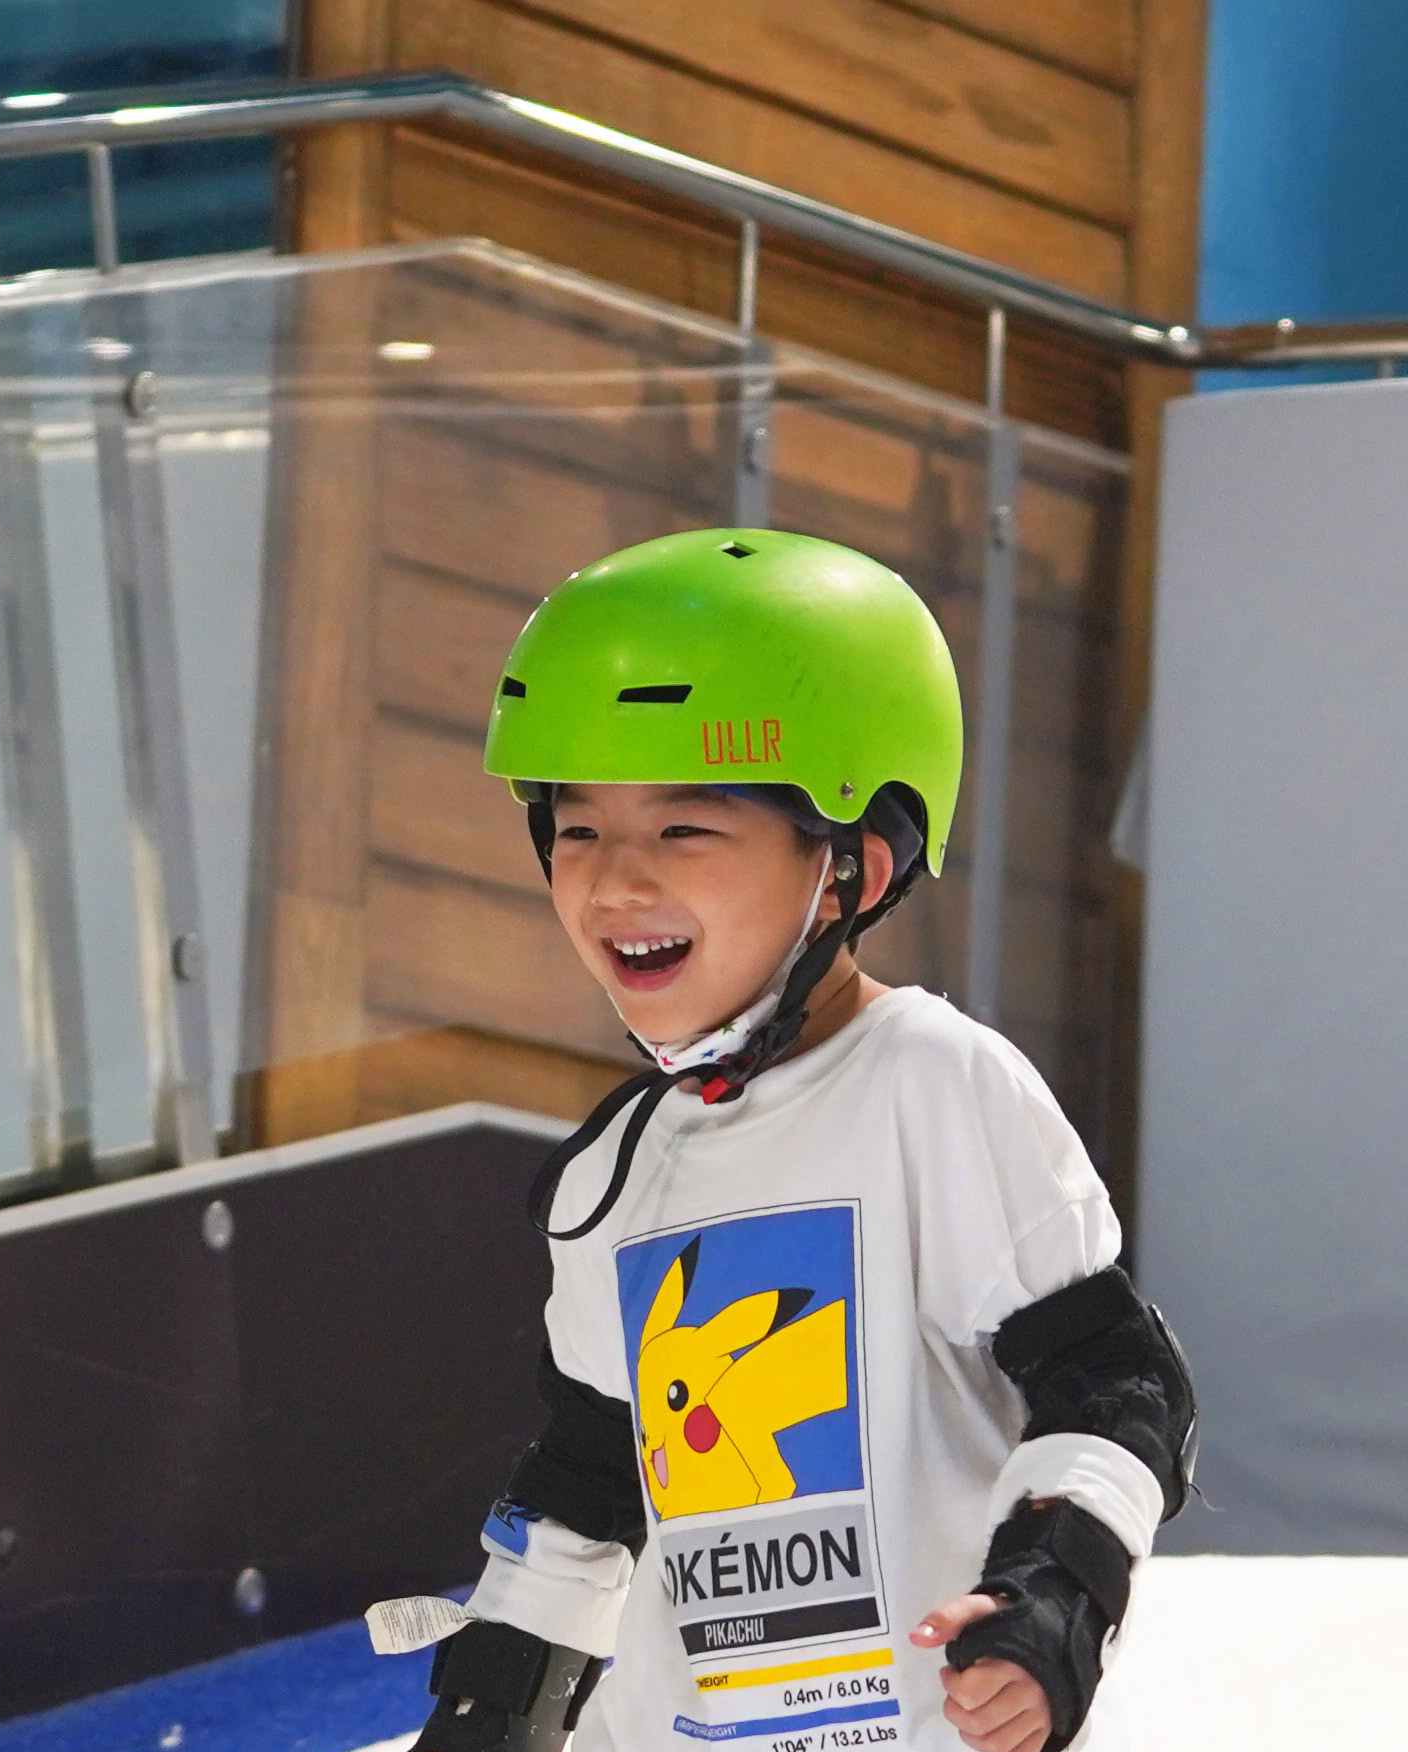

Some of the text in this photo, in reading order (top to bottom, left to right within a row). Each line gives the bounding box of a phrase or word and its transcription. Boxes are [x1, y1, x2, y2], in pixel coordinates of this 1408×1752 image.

[702, 718, 782, 764] ULLR
[704, 1617, 765, 1648] PIKACHU
[783, 1688, 823, 1706] 0.4m
[836, 1679, 862, 1697] 6.0
[865, 1675, 890, 1695] Kg
[831, 1729, 864, 1748] 13.2
[866, 1726, 898, 1743] Lbs
